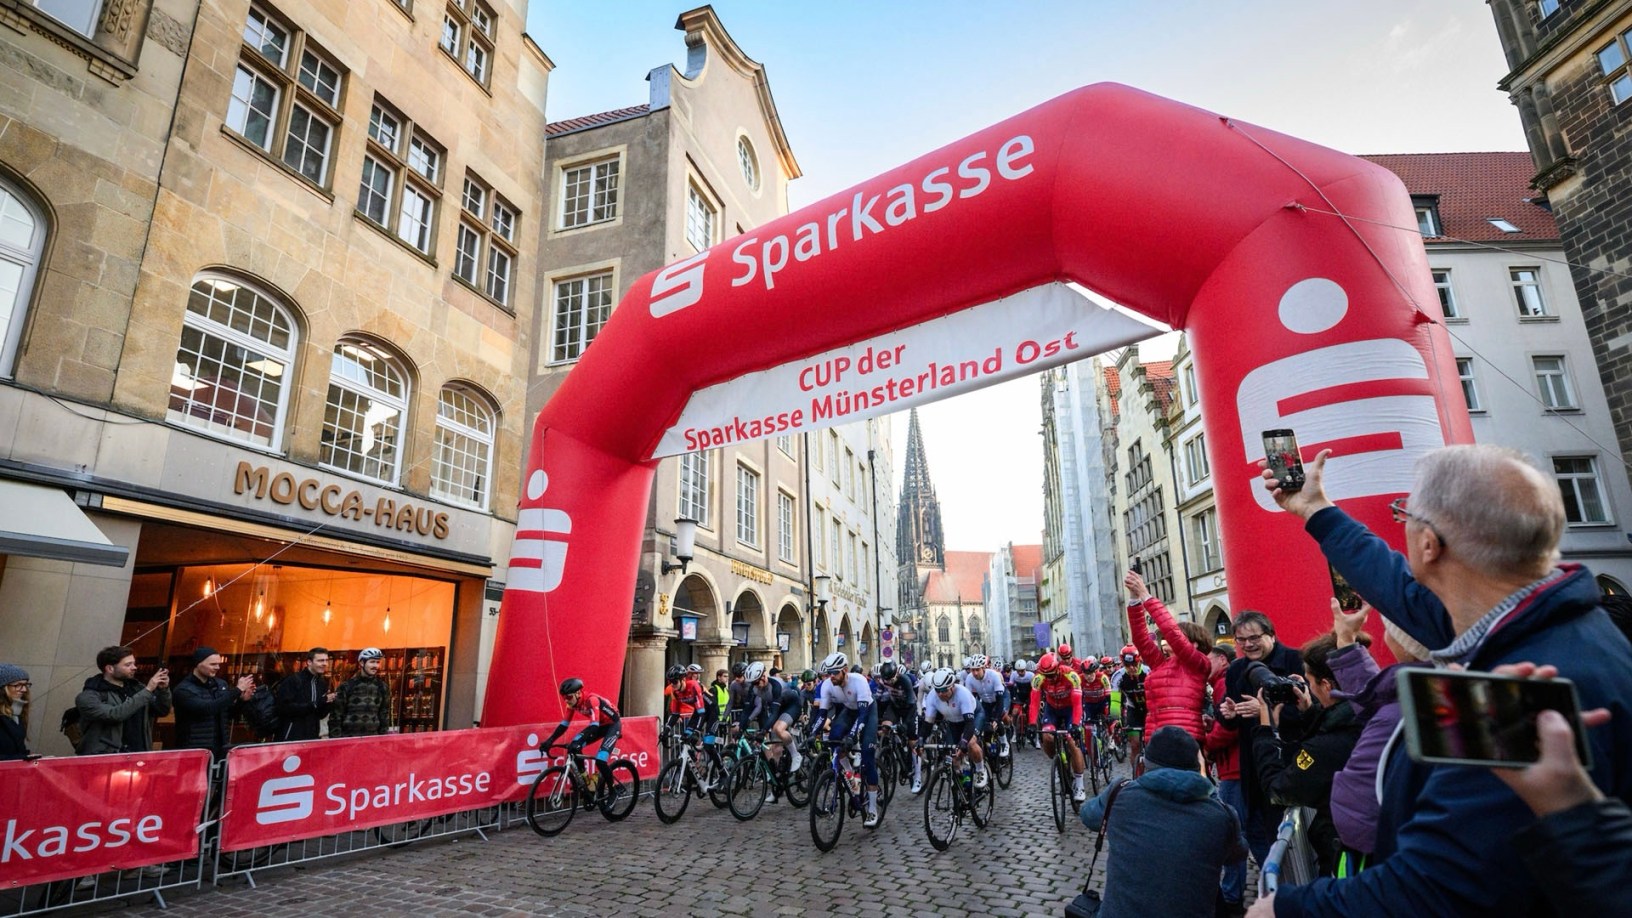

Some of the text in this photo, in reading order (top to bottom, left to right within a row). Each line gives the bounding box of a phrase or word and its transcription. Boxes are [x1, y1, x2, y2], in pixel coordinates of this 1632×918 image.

[731, 134, 1036, 290] Sparkasse
[684, 330, 1080, 451] Sparkasse Münsterland Ost
[799, 343, 906, 392] CUP der
[234, 460, 450, 540] MOCCA-HAUS
[324, 771, 491, 820] Sparkasse
[0, 814, 163, 863] kasse
